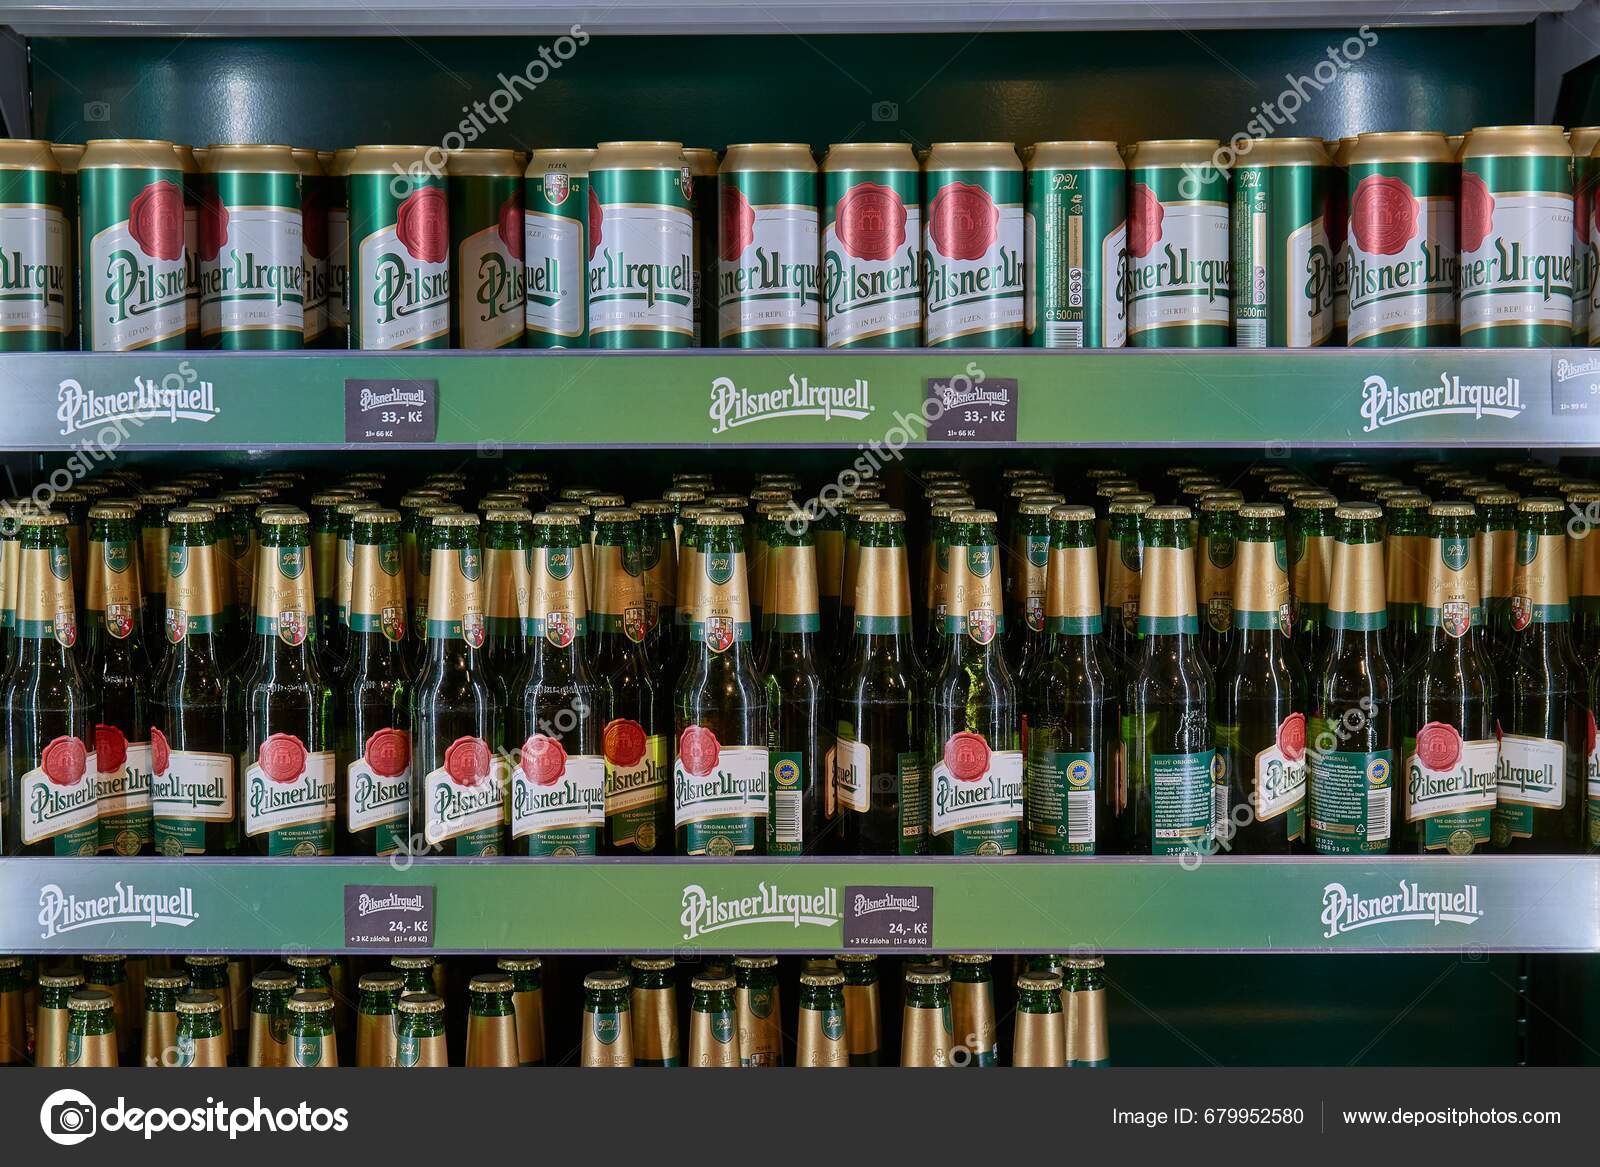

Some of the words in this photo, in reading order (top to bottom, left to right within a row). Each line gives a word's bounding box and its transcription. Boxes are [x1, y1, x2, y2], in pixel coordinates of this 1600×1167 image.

[105, 249, 186, 324] Pilsne
[231, 249, 303, 307] Urque
[604, 247, 691, 309] Urquell
[823, 250, 910, 321] Pilsner
[57, 379, 138, 435] Pilsner
[134, 375, 214, 423] Urquell
[360, 388, 394, 412] Pilsner
[392, 387, 424, 407] Urquell
[381, 411, 405, 425] 33,-
[408, 411, 423, 423] Kč
[709, 377, 792, 433] Pilsner
[789, 373, 869, 421] Urquell
[943, 388, 977, 411] Pilsner
[975, 386, 1008, 406] Urquell
[964, 410, 988, 424] 33,-
[991, 410, 1006, 422] Kč
[1360, 375, 1444, 432] Pilsner
[1440, 371, 1520, 420] Urquell
[169, 772, 224, 808] Urquell
[676, 769, 721, 810] Pilsner
[718, 771, 766, 804] Urquell
[1409, 765, 1462, 805] Pilsner
[1500, 756, 1553, 793] Urquell
[31, 782, 87, 824] Pilsner
[250, 777, 307, 818] Pilsner
[434, 782, 490, 824] Pilsner
[514, 779, 567, 820] Pilsner
[937, 776, 991, 817] Pilsner
[38, 884, 118, 939] Pilsner
[115, 881, 193, 928] Urquell
[359, 893, 392, 917] Pilsner
[390, 892, 422, 912] Urquell
[680, 884, 762, 940] Pilsner
[758, 880, 837, 928] Urquell
[854, 893, 887, 917] Pilsner
[885, 892, 918, 913] Urquell
[1321, 882, 1403, 938] Pilsner
[1400, 879, 1478, 926] Urquell
[389, 921, 412, 933] 24,-
[414, 920, 428, 932] Kč
[889, 923, 911, 935] 24,-
[914, 922, 928, 934] Kč
